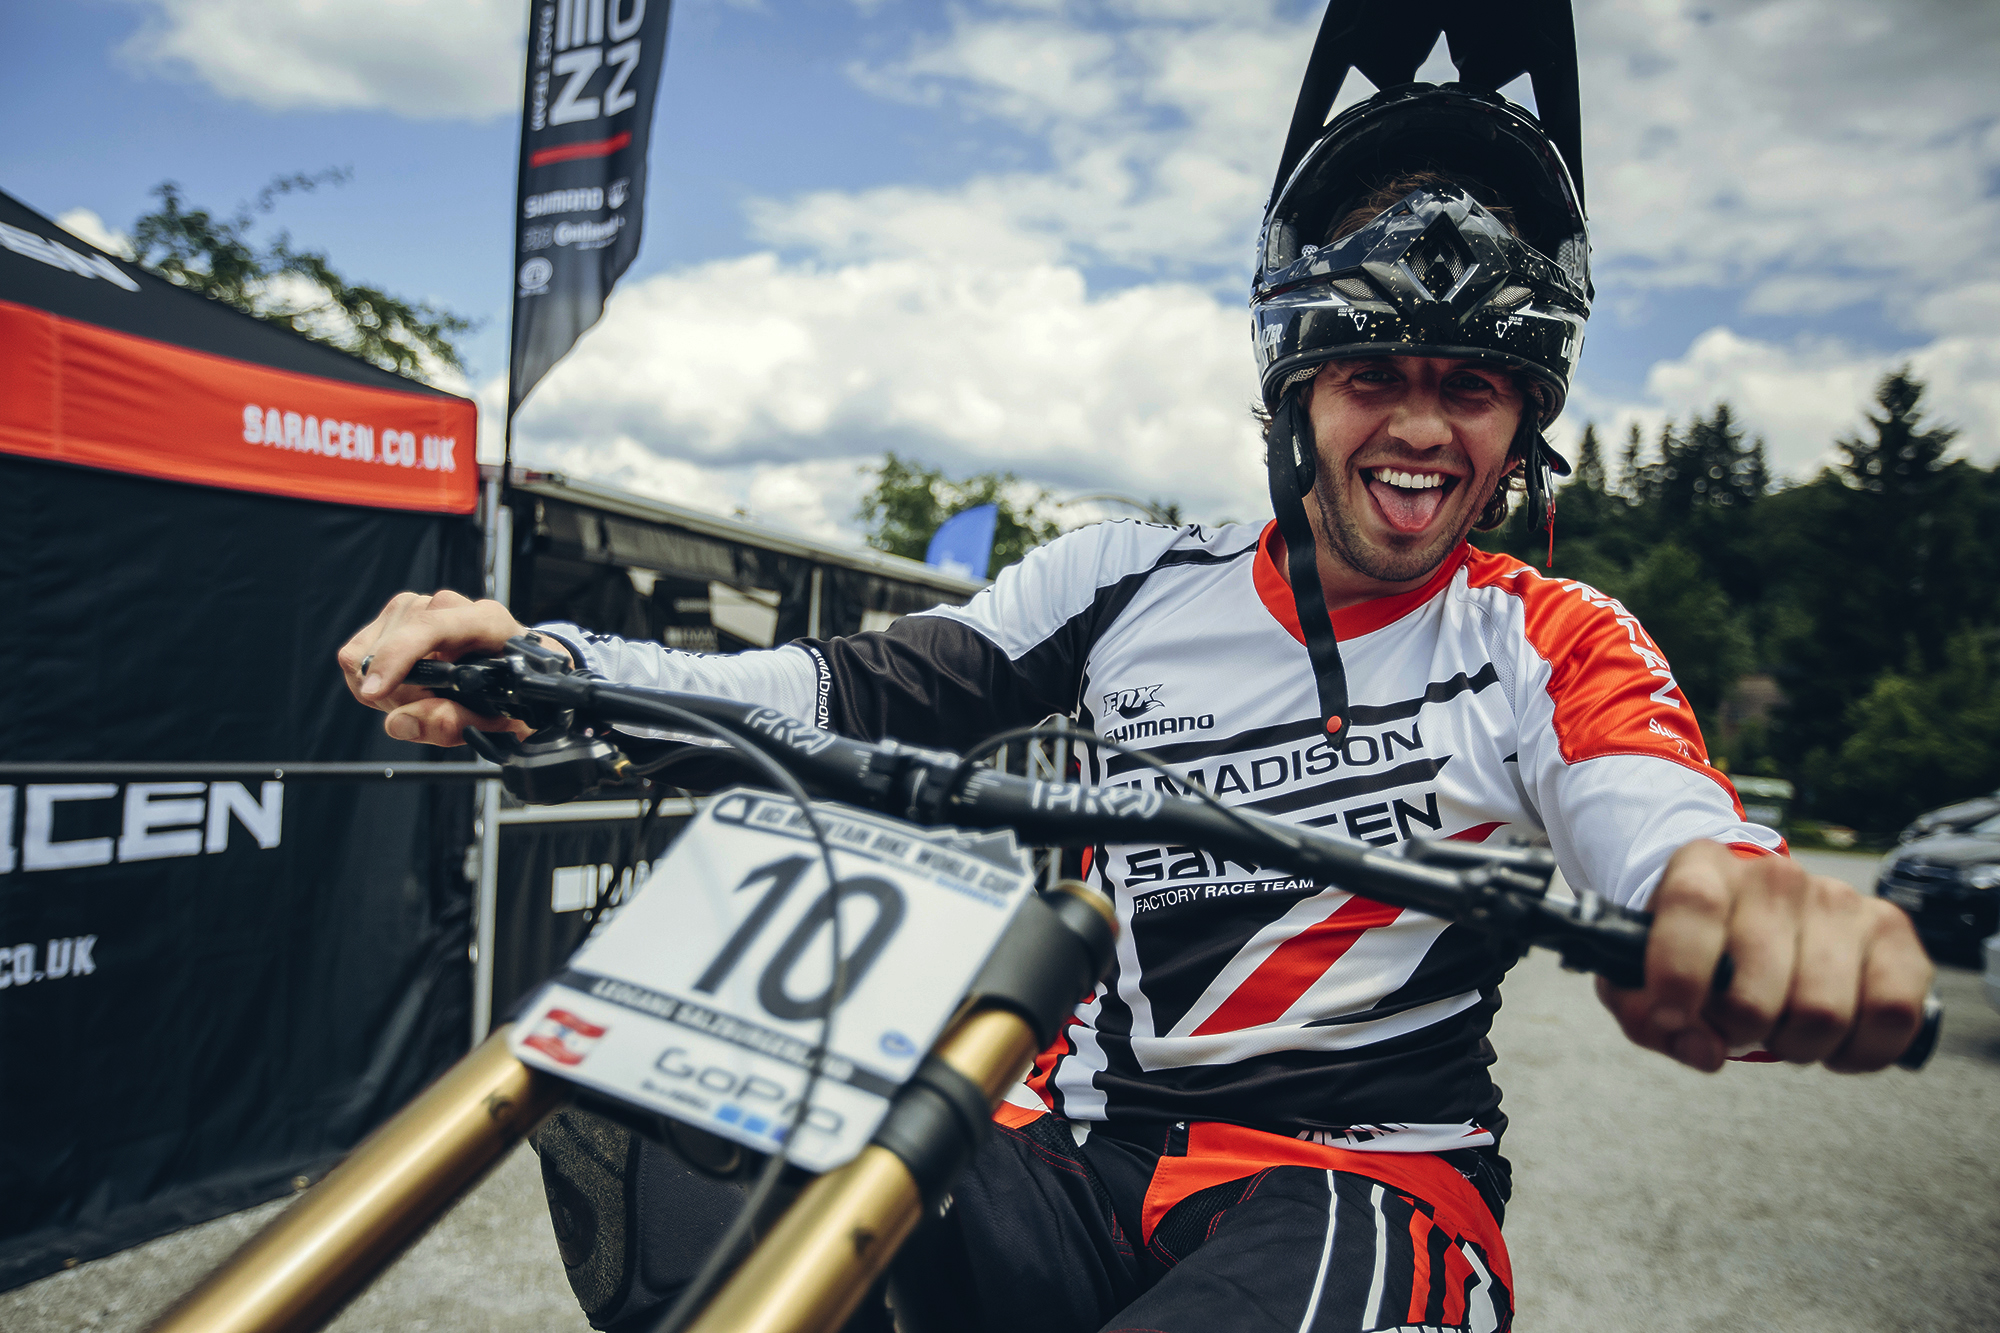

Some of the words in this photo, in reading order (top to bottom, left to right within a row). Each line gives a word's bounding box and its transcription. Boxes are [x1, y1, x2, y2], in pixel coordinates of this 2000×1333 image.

[242, 402, 457, 472] SARACEN.CO.UK
[1102, 682, 1165, 720] FOX
[1104, 713, 1216, 747] SHIMANO
[1153, 721, 1424, 801] MADISON
[1135, 886, 1201, 914] FACTORY
[1204, 882, 1256, 899] RACE
[1261, 879, 1314, 893] TEAM
[692, 853, 909, 1022] 10
